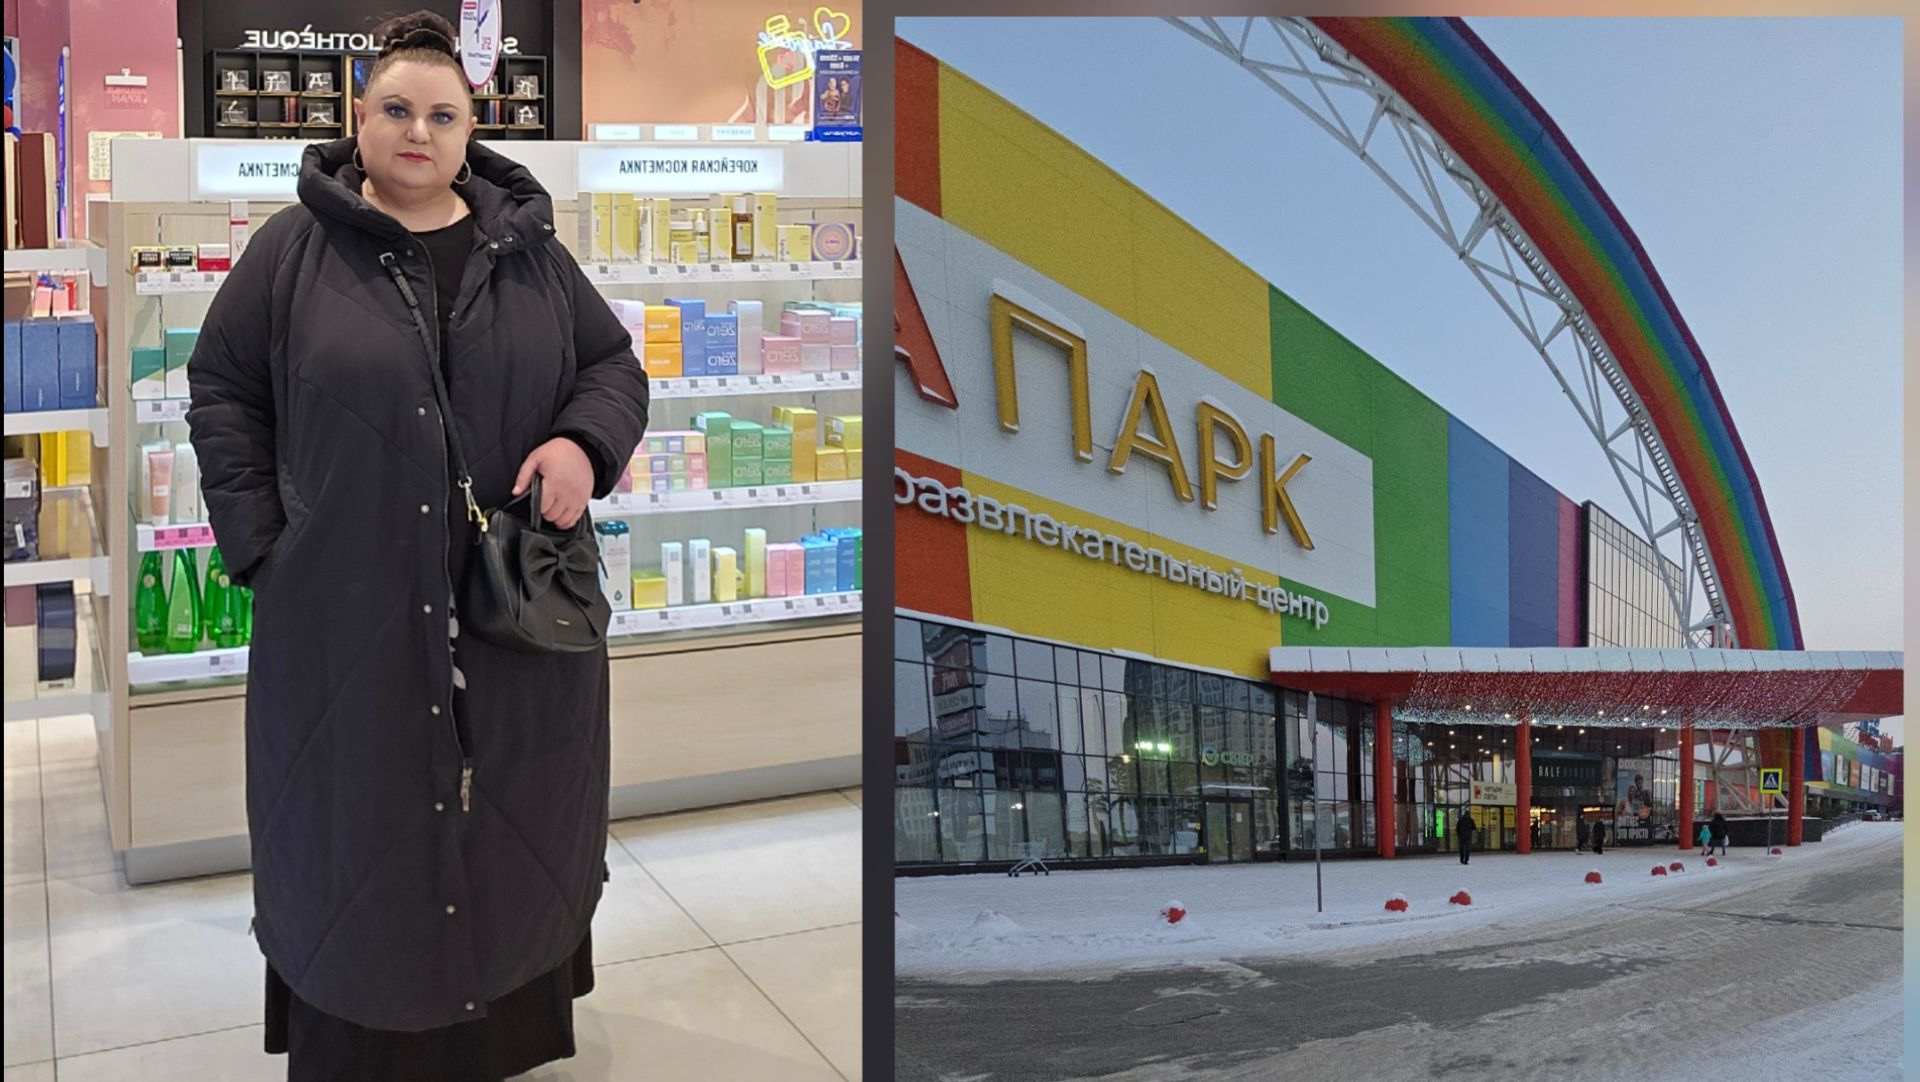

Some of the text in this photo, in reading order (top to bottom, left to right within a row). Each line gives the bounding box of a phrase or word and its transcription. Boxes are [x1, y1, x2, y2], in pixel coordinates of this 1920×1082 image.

[990, 290, 1315, 551] ПАРК
[1256, 582, 1329, 629] центр
[1538, 765, 1560, 777] RALF
